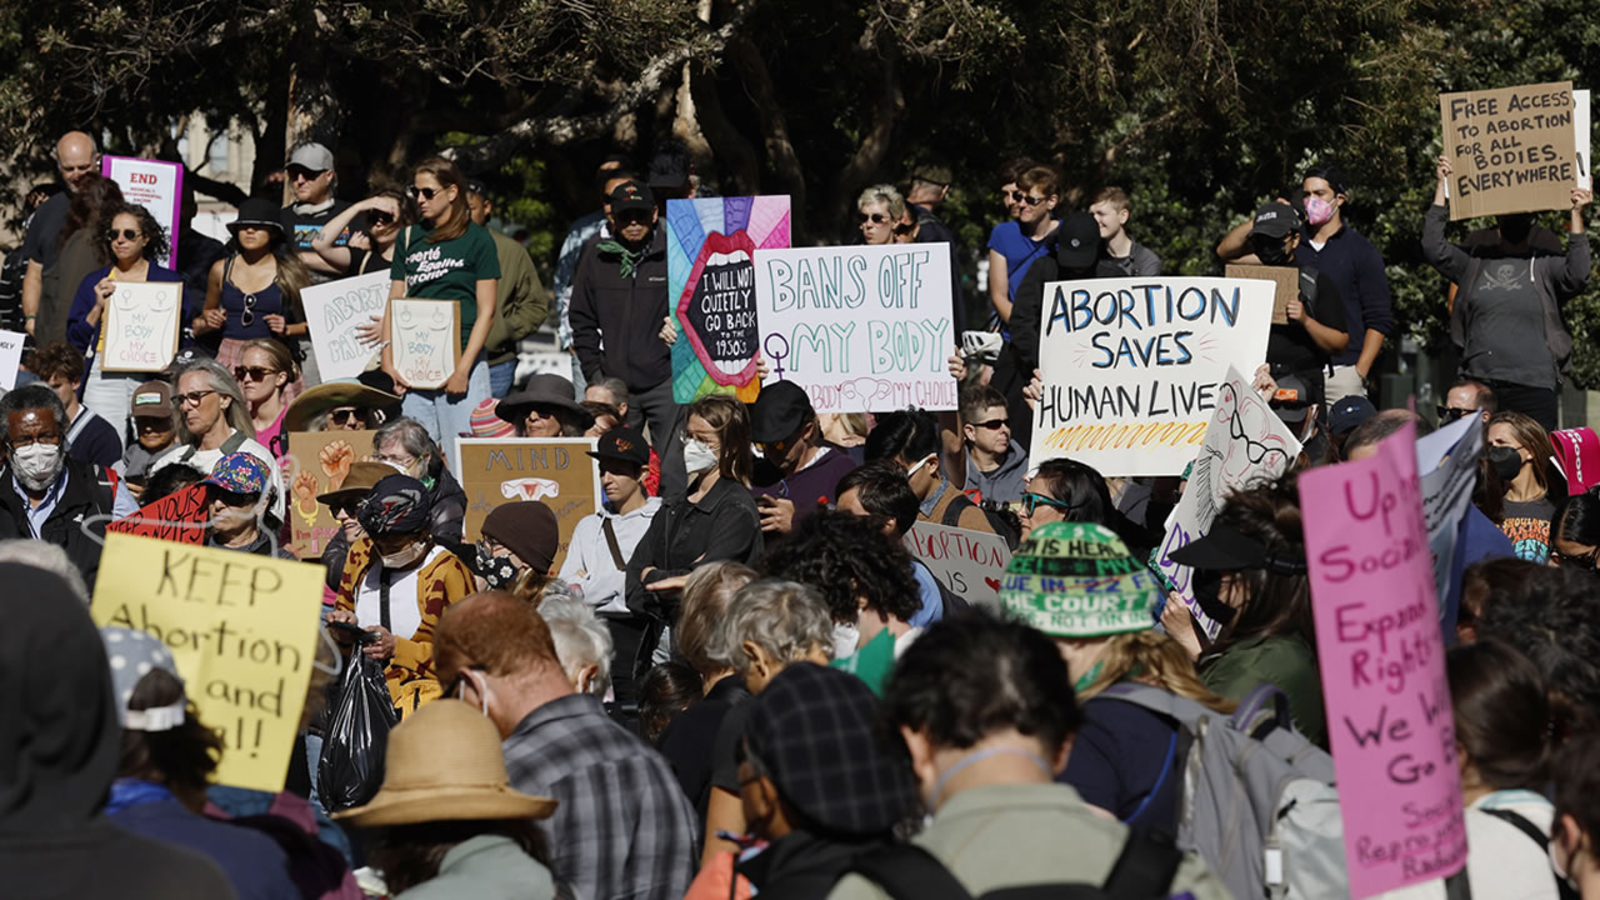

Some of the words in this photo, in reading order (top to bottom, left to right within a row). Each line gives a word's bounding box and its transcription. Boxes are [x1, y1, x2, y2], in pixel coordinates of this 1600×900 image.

[1450, 97, 1499, 122] FREE
[1507, 91, 1570, 112] ACCESS
[1457, 125, 1480, 140] TO
[1486, 110, 1571, 135] ABORTION
[1455, 142, 1483, 158] FOR
[1490, 135, 1522, 152] ALL
[130, 172, 158, 185] END
[702, 274, 709, 291] I
[711, 270, 737, 291] WILL
[737, 266, 754, 287] NOT
[767, 254, 867, 312] BANS
[878, 250, 930, 309] OFF
[701, 289, 751, 314] QUIETLY
[1046, 284, 1241, 337] ABORTION
[705, 314, 721, 332] GO
[727, 311, 756, 331] BACK
[119, 350, 157, 364] CHOICE
[790, 320, 856, 374] MY
[867, 317, 950, 375] BODY
[1091, 331, 1194, 369] SAVES
[405, 370, 442, 382] CHOICE
[811, 384, 842, 410] BODY
[893, 381, 912, 407] MY
[915, 380, 957, 407] CHOICE
[1039, 383, 1141, 428] HUMAN
[1148, 380, 1218, 417] LIVE
[485, 446, 571, 471] MIND
[157, 484, 201, 522] YOUR
[156, 549, 284, 607] KEEP
[945, 569, 968, 594] IS
[1044, 593, 1139, 612] COURT
[205, 678, 285, 719] and
[1343, 704, 1412, 747] We
[1387, 754, 1437, 785] Go
